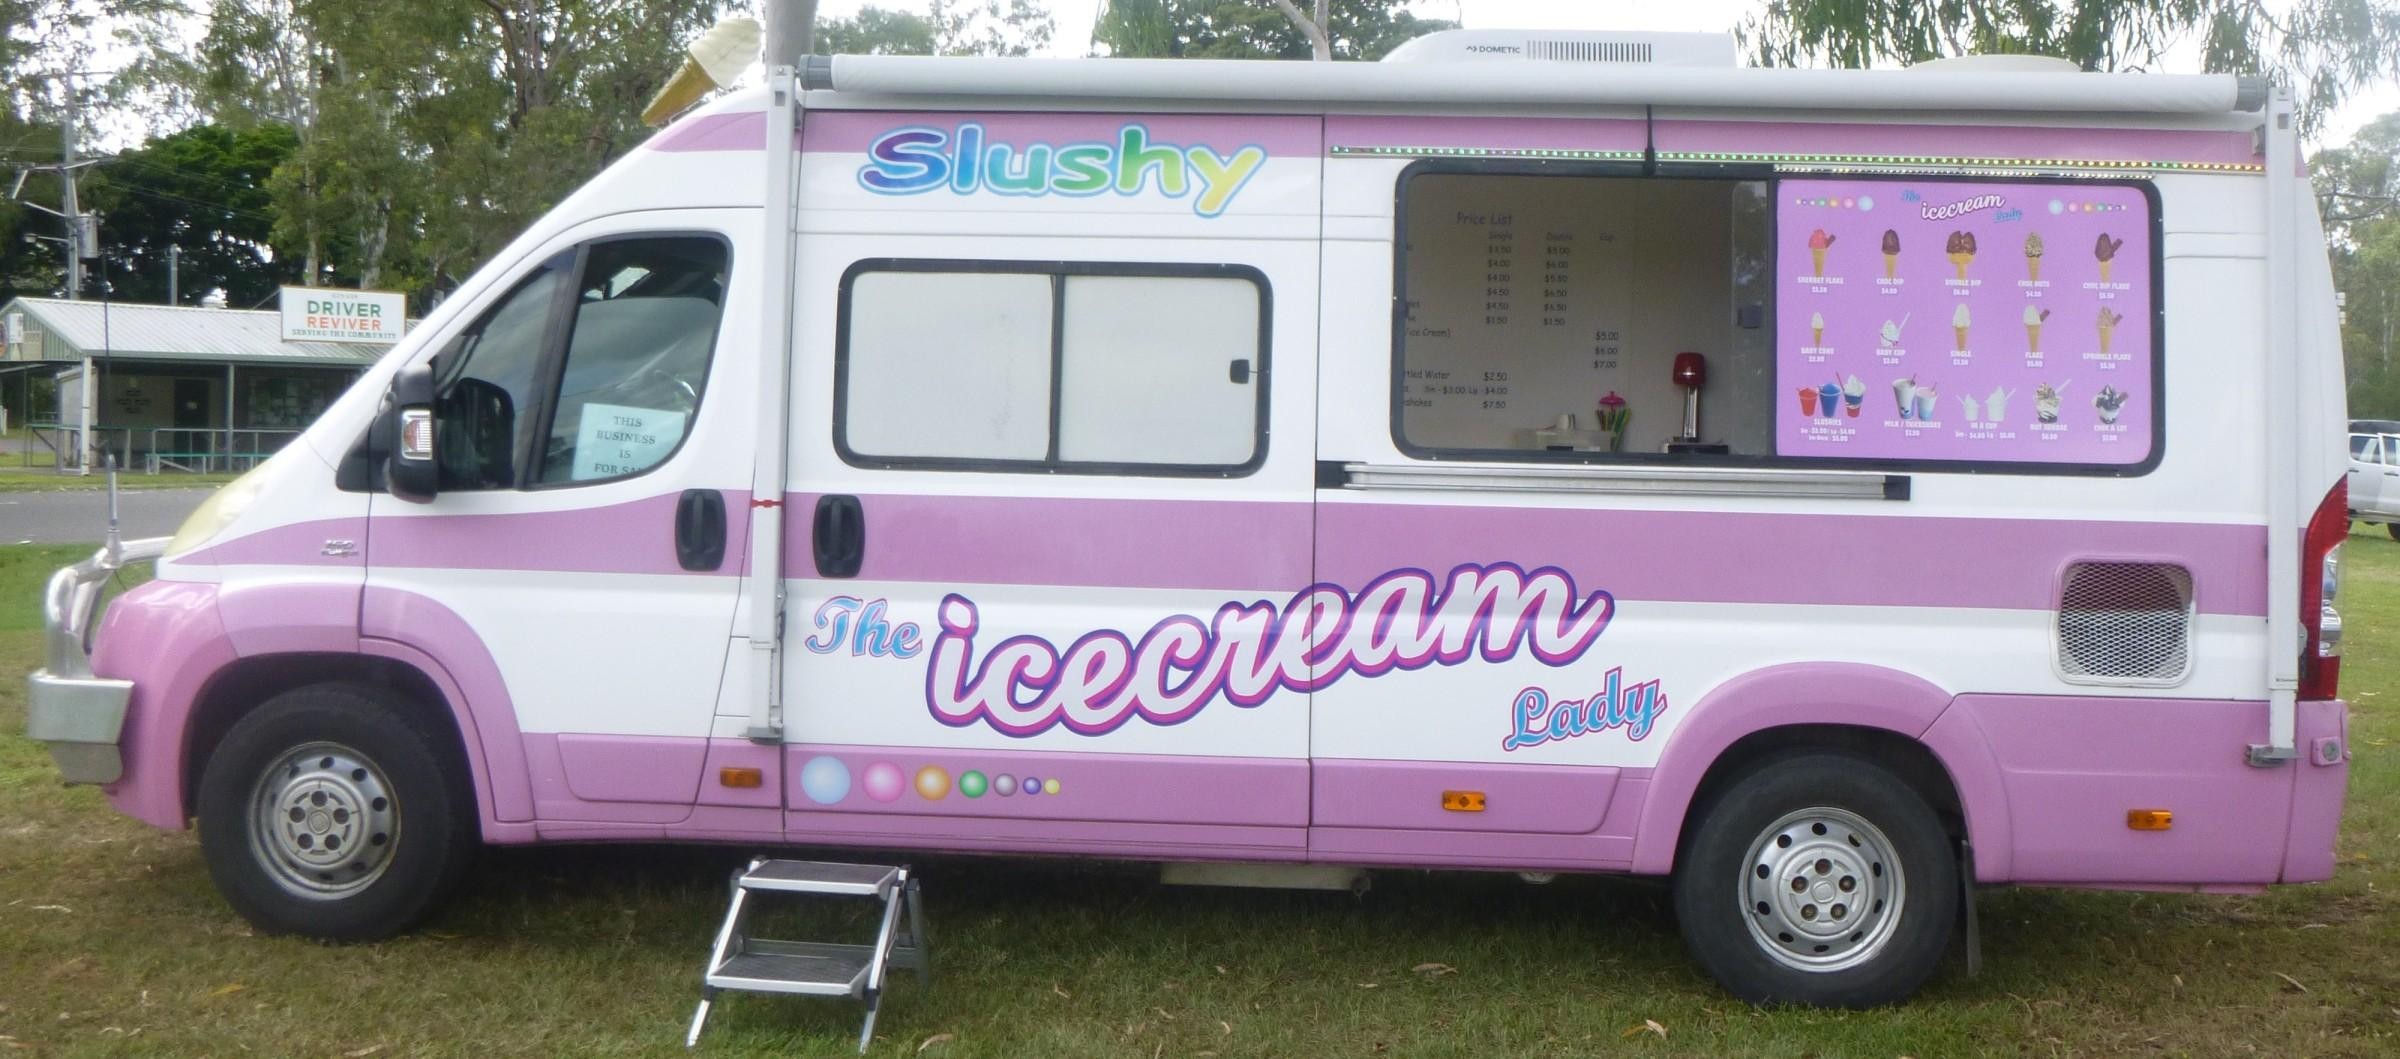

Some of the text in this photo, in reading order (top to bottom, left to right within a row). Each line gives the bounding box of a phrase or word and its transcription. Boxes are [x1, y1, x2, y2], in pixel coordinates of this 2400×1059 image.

[1479, 45, 1521, 54] DOMETIC
[857, 122, 1268, 218] Slushy
[1920, 194, 2006, 220] icecream
[1456, 211, 1512, 225] Price List
[307, 300, 382, 318] DRIVER
[307, 316, 382, 331] REVIVER
[292, 328, 396, 339] SERVING THE COMMUNITY
[1424, 370, 1450, 380] Water
[613, 415, 643, 428] THIS
[596, 430, 657, 445] BUSINESS
[619, 450, 632, 459] IS
[594, 463, 618, 474] FOR
[804, 560, 1667, 752] The icecream Lady
